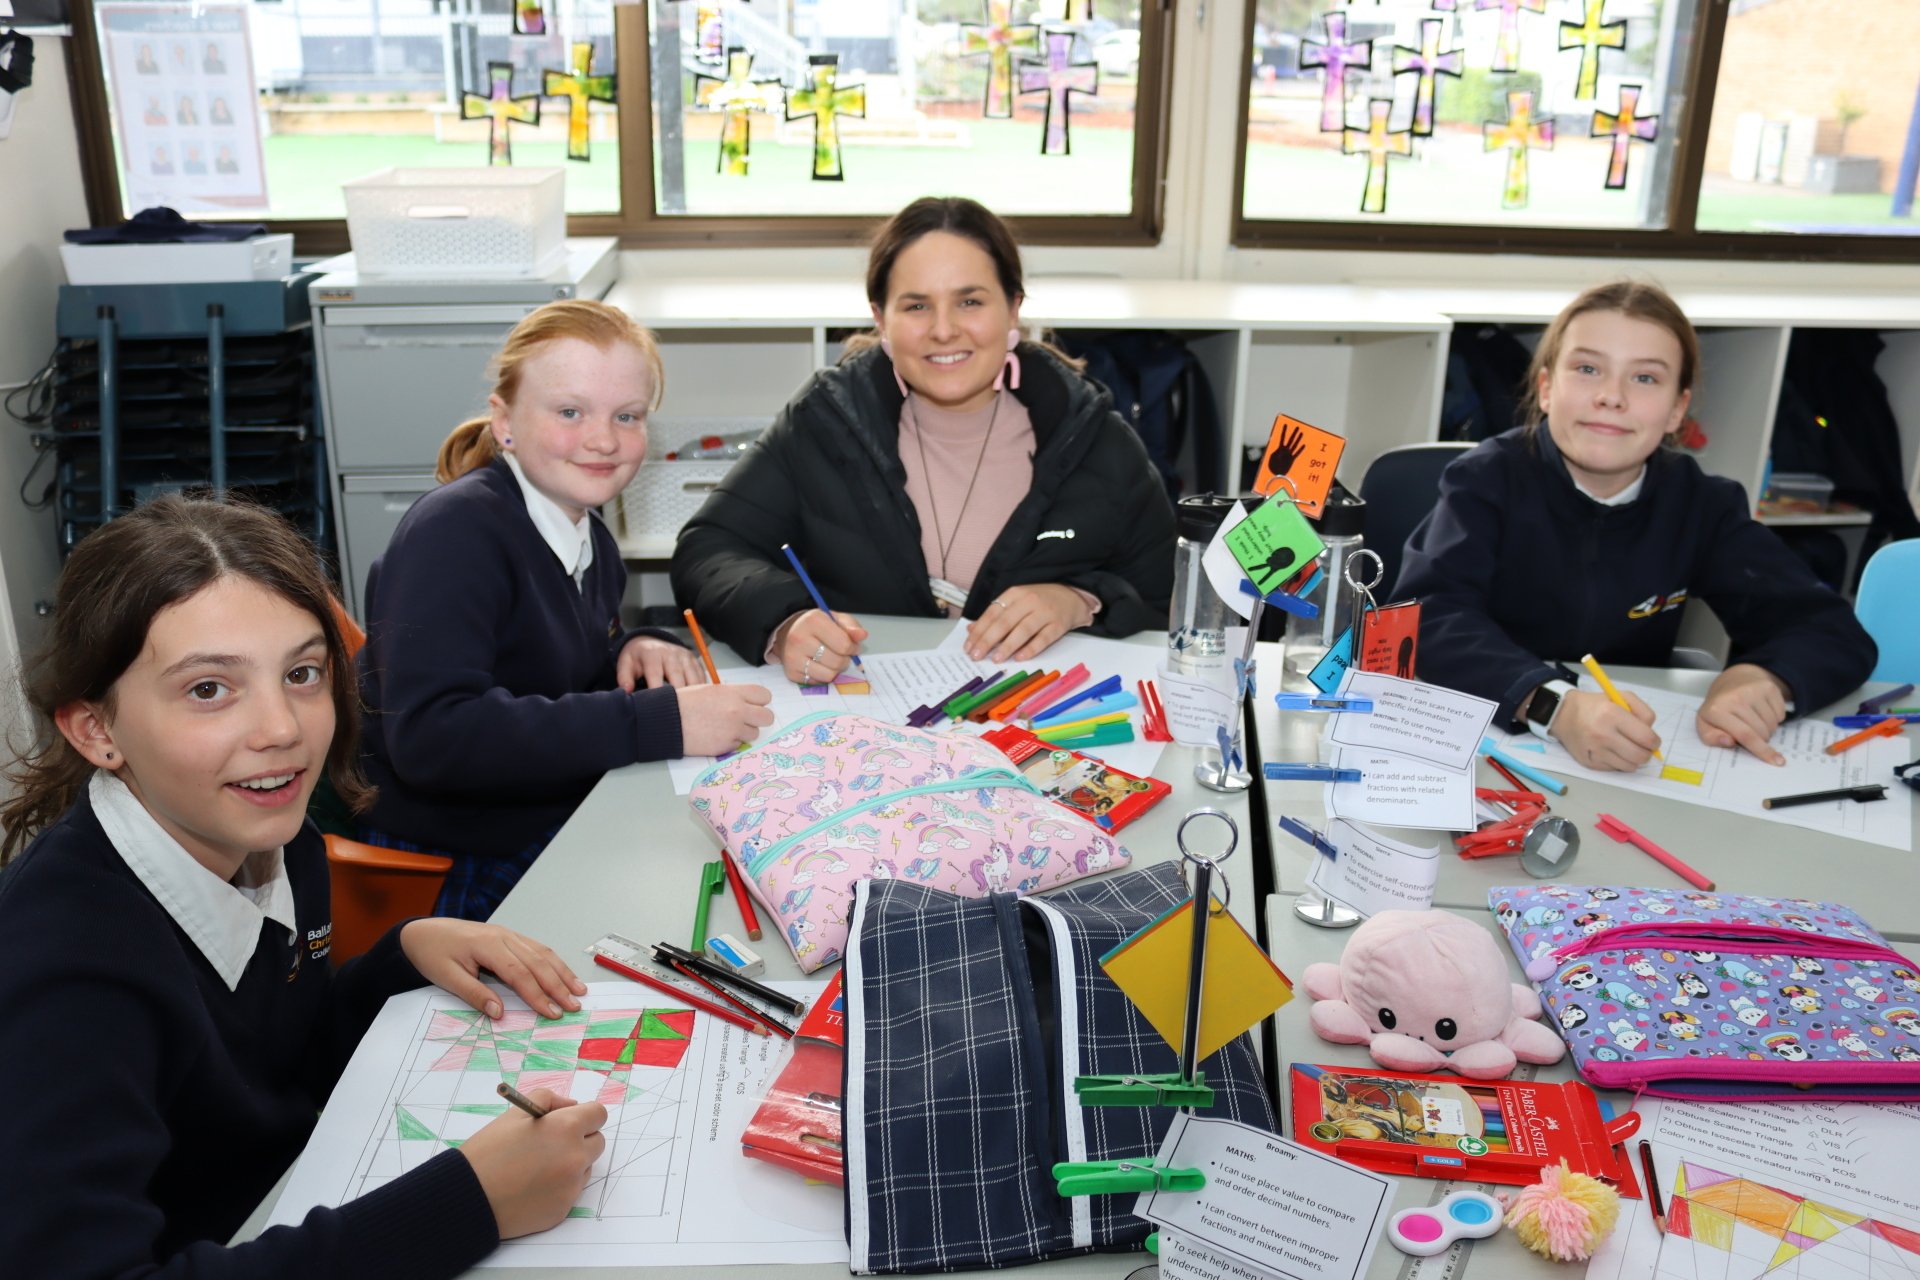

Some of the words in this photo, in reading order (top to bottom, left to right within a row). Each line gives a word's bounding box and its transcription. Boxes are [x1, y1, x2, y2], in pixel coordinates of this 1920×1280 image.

[1320, 443, 1327, 452] I
[1309, 459, 1326, 469] got
[1378, 699, 1407, 711] specific
[1413, 698, 1428, 706] can
[1429, 703, 1446, 712] scan
[1446, 707, 1462, 715] text
[1463, 711, 1475, 720] for
[1369, 722, 1412, 738] connectives
[1413, 731, 1421, 739] in
[1422, 735, 1434, 744] my
[1400, 717, 1410, 726] To
[1410, 721, 1425, 730] use
[1425, 725, 1446, 736] more
[1386, 773, 1401, 781] add
[1417, 775, 1448, 783] subtract
[1367, 784, 1399, 793] fractions
[1400, 785, 1417, 793] with
[1418, 787, 1445, 795] related
[1346, 866, 1357, 875] not
[1358, 873, 1369, 883] call
[1369, 880, 1382, 890] out
[1391, 889, 1405, 900] talk
[1406, 894, 1425, 902] over
[1349, 855, 1357, 864] To
[1357, 861, 1384, 879] exercise
[1384, 876, 1427, 892] self-control
[720, 1042, 729, 1063] created
[739, 1044, 750, 1065] Triangle
[760, 1041, 770, 1062] Triangle
[712, 1103, 721, 1118] color
[1707, 1106, 1746, 1122] Scalene
[1748, 1117, 1787, 1133] Triangle
[1762, 1110, 1800, 1126] Triangle
[1510, 1118, 1519, 1135] Colour
[1519, 1087, 1549, 1157] FABER-CASTELL
[1664, 1106, 1675, 1114] 6)
[1676, 1109, 1711, 1124] Obtuse
[1712, 1120, 1752, 1136] Scalene
[1755, 1131, 1794, 1148] Triangle
[1514, 1135, 1525, 1153] Pencils
[1662, 1116, 1673, 1125] 7)
[1674, 1120, 1709, 1135] Obtuse
[1711, 1131, 1757, 1149] Isosceles
[1760, 1145, 1799, 1162] Triangle
[1822, 1139, 1842, 1150] VIS
[1225, 1145, 1257, 1163] MATHS:
[1266, 1142, 1299, 1161] Broamy:
[1659, 1127, 1685, 1139] Color
[1698, 1139, 1714, 1149] the
[1716, 1146, 1752, 1161] spaces
[1753, 1156, 1792, 1172] created
[1794, 1168, 1822, 1182] using
[1834, 1181, 1872, 1196] pre-set
[1873, 1193, 1901, 1205] color
[1832, 1167, 1857, 1179] KOS
[1214, 1176, 1232, 1189] and
[1232, 1184, 1257, 1199] order
[1257, 1193, 1292, 1213] decimal
[1291, 1208, 1333, 1230] numbers.
[1219, 1162, 1224, 1170] I
[1224, 1164, 1240, 1177] can
[1241, 1172, 1256, 1183] use
[1256, 1178, 1281, 1193] place
[1281, 1188, 1305, 1203] value
[1306, 1198, 1316, 1208] to
[1317, 1203, 1356, 1224] compare
[1200, 1214, 1238, 1238] fractions
[1238, 1229, 1257, 1245] and
[1256, 1238, 1284, 1256] mixed
[1283, 1250, 1325, 1273] numbers.
[1205, 1202, 1210, 1210] I
[1209, 1205, 1226, 1217] can
[1226, 1211, 1259, 1231] convert
[1259, 1221, 1298, 1247] between
[1299, 1240, 1340, 1264] improper
[1167, 1256, 1221, 1280] understand
[1173, 1240, 1185, 1253] To
[1185, 1247, 1209, 1262] seek
[1209, 1254, 1230, 1272] help
[1231, 1265, 1258, 1280] when
